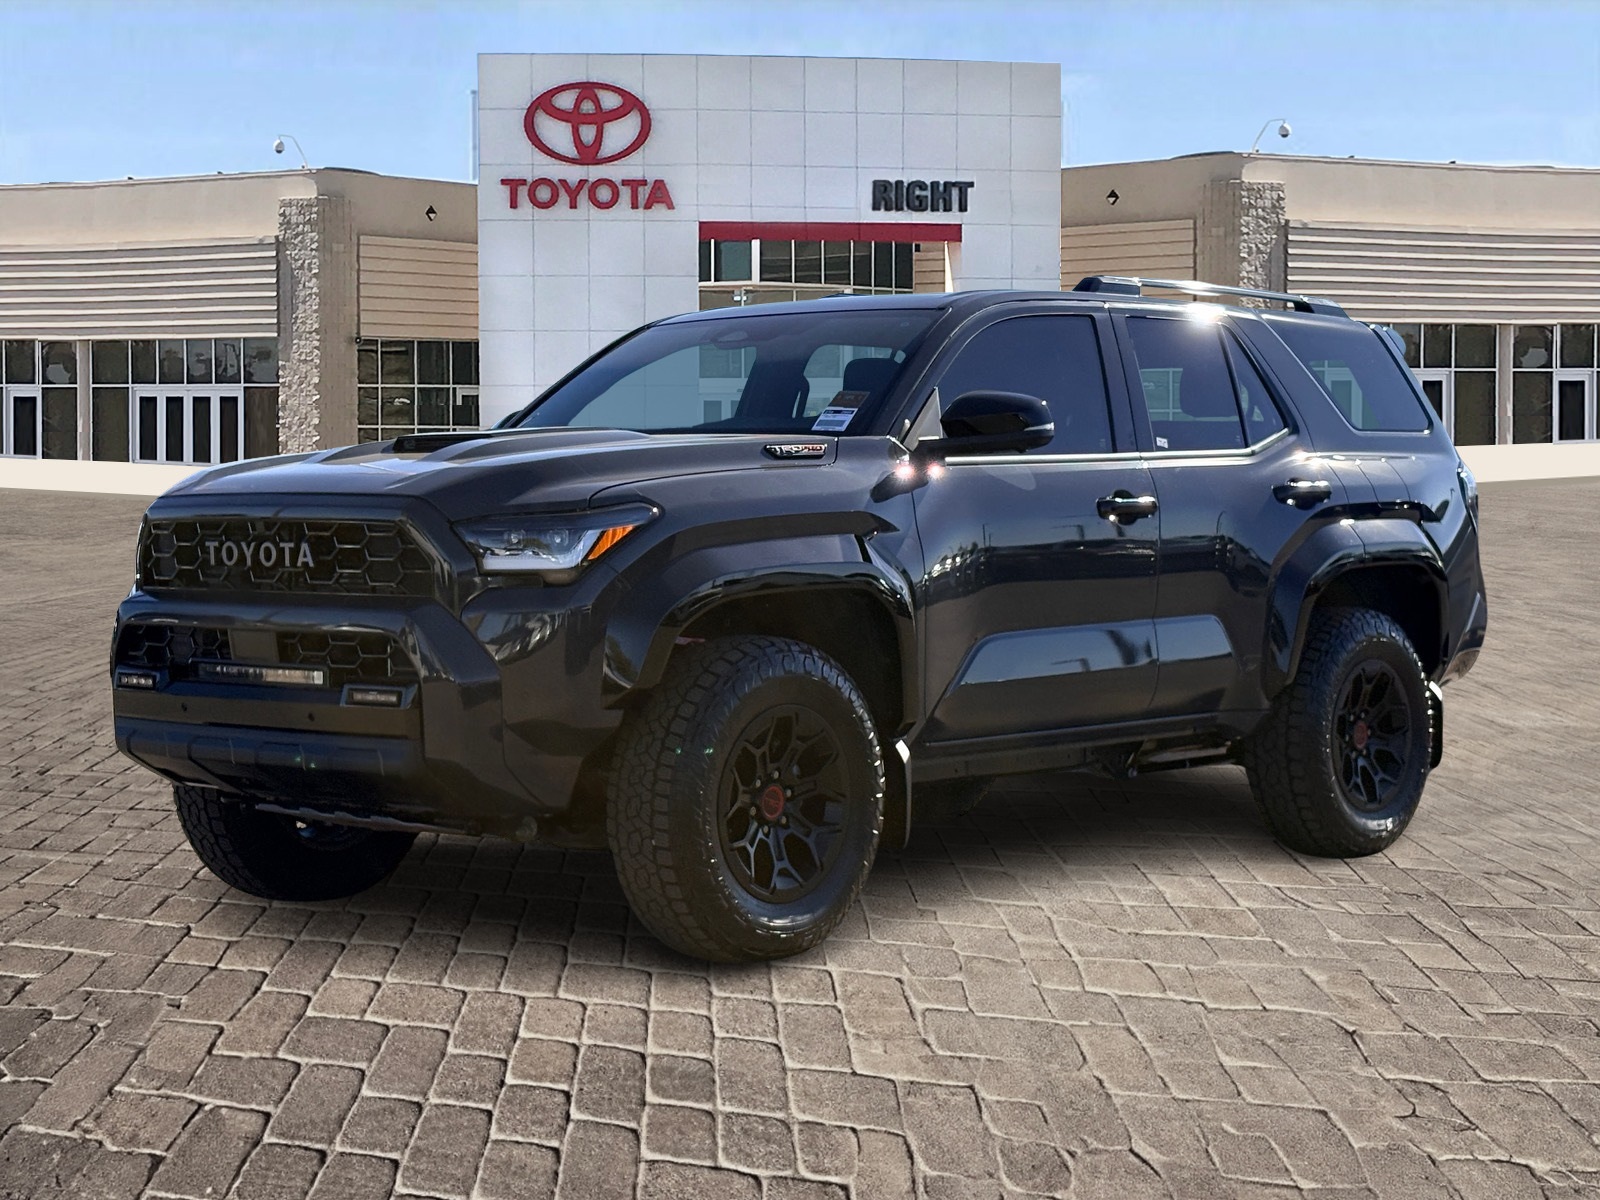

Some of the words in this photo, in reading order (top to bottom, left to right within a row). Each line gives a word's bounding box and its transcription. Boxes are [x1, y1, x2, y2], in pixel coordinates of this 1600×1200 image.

[500, 178, 675, 210] TOYOTA
[872, 179, 975, 213] RIGHT
[205, 540, 315, 568] TOYOTA
